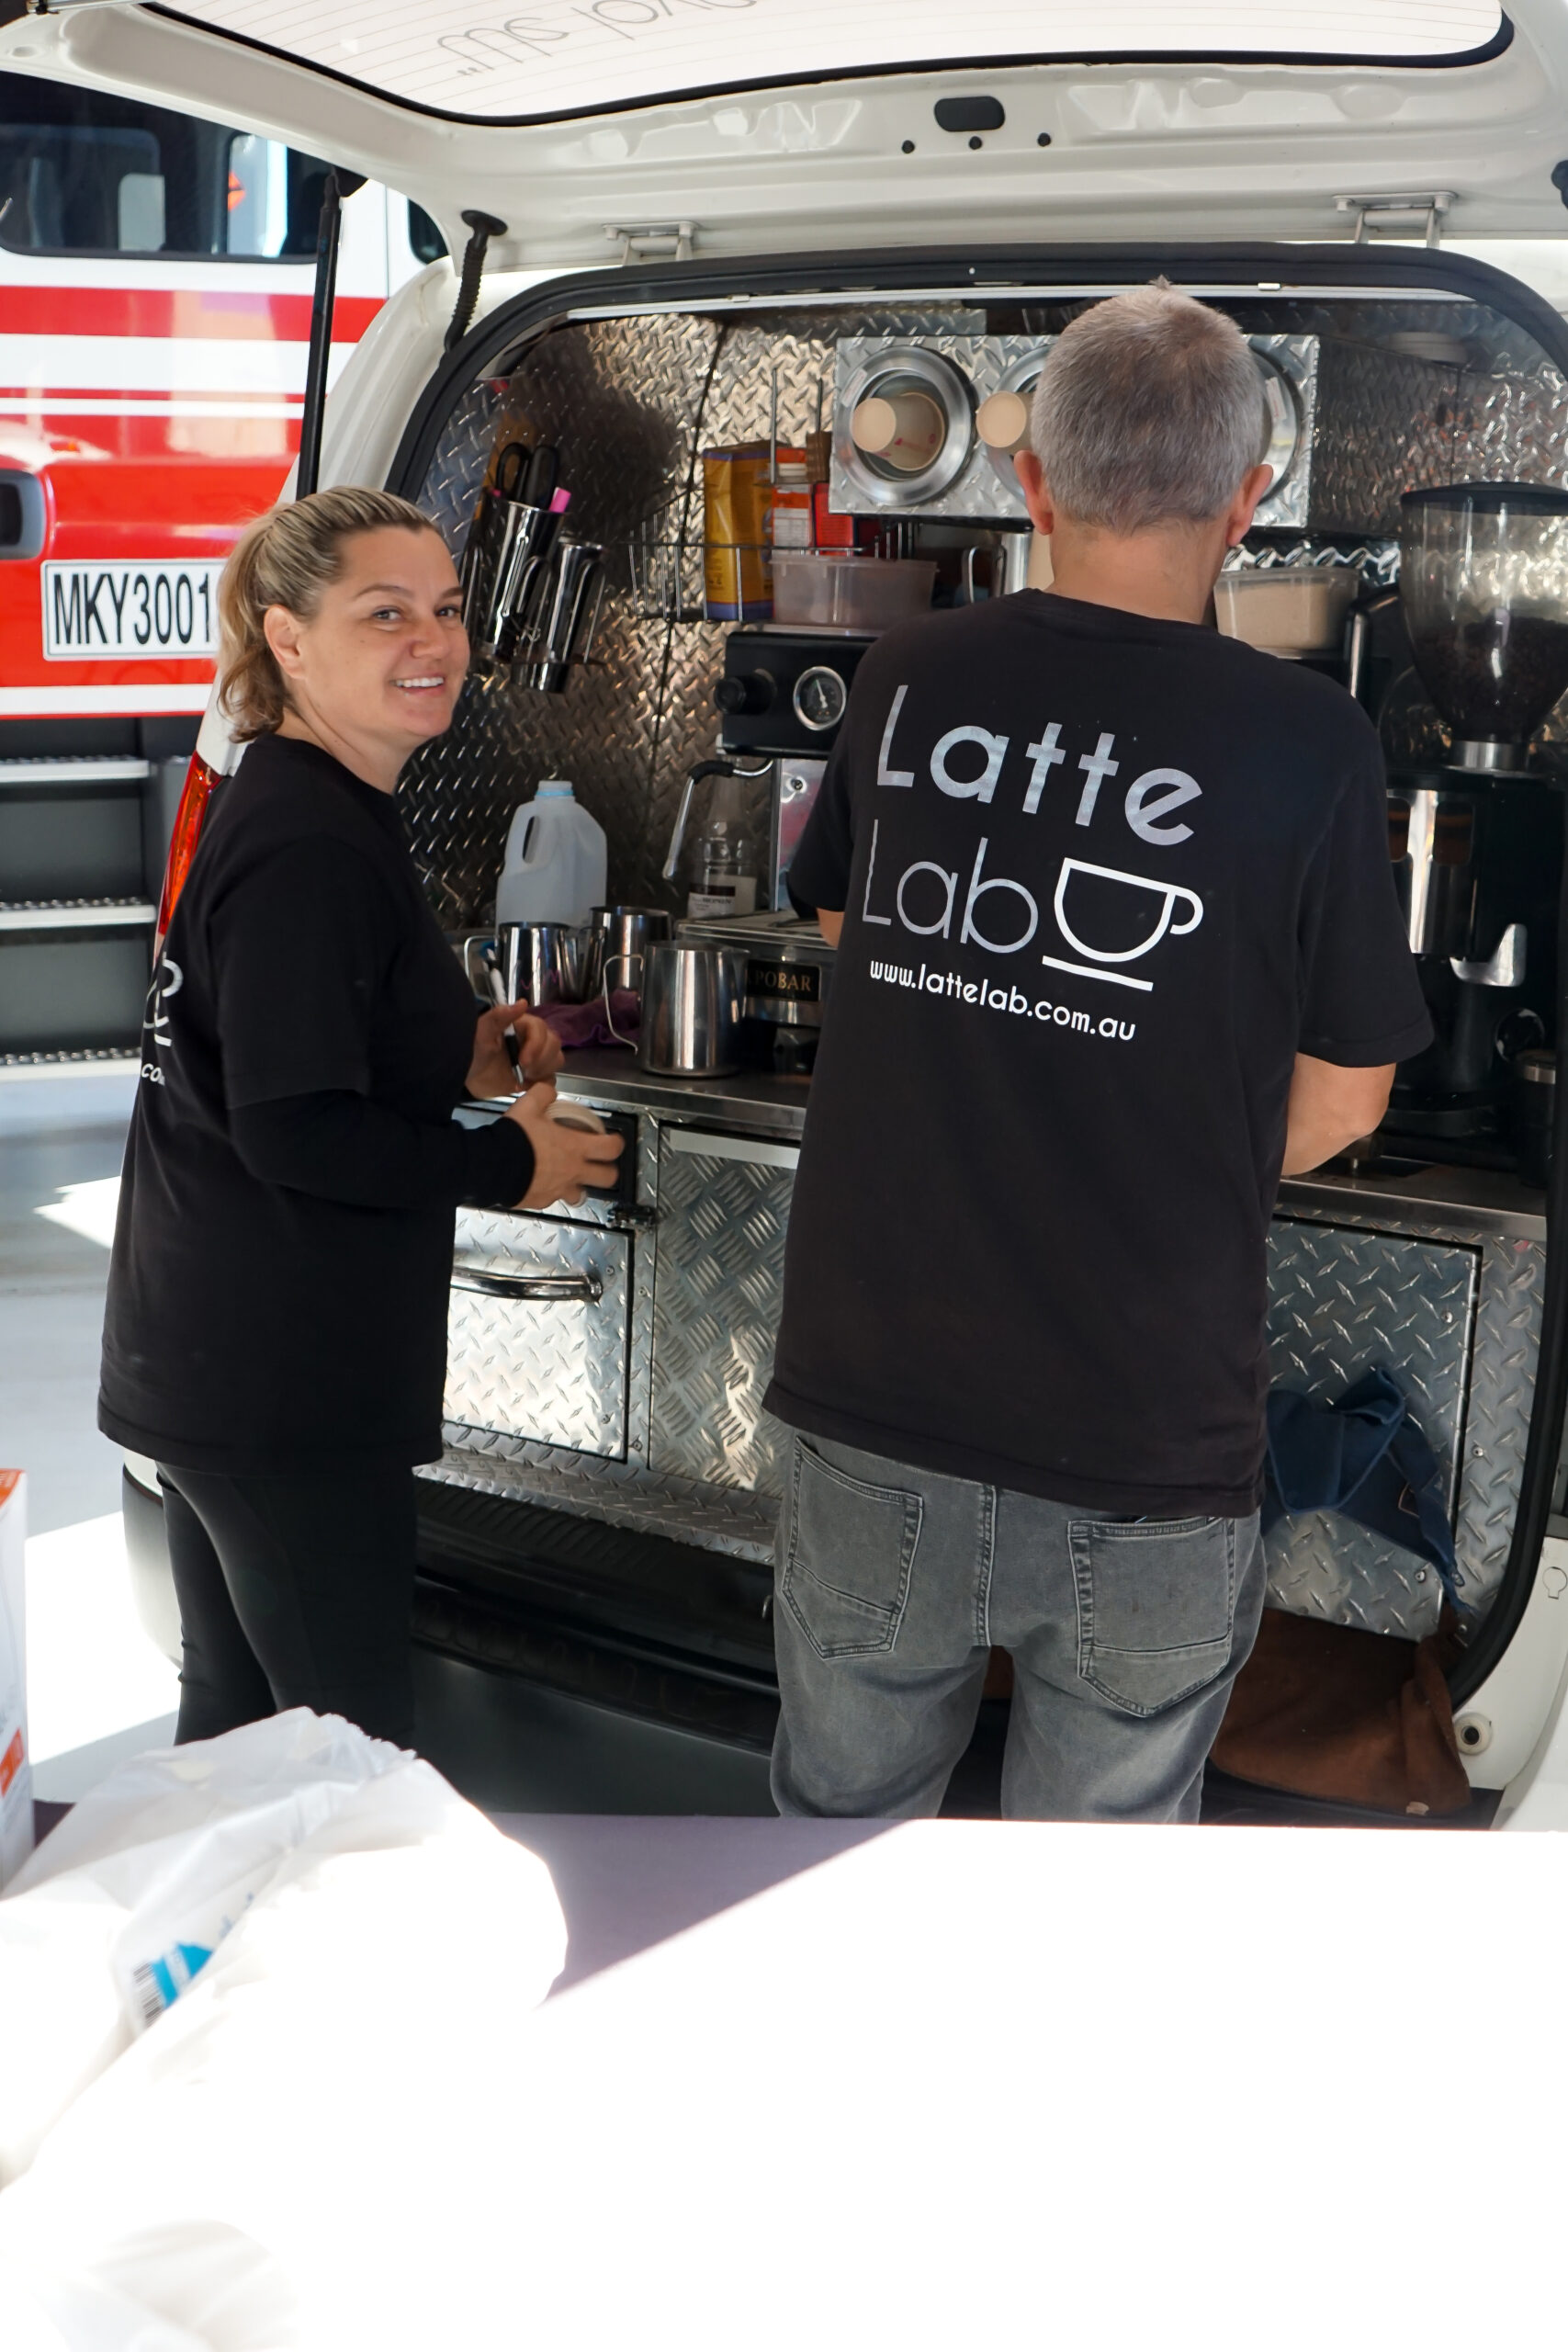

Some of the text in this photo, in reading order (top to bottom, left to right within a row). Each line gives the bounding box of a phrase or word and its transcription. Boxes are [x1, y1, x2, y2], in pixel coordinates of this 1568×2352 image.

[53, 573, 210, 644] MKY3001
[876, 684, 1203, 846] Latte
[862, 819, 1039, 954] Lab
[749, 969, 812, 992] POBAR
[869, 960, 1136, 1041] www.lattelab.com.au
